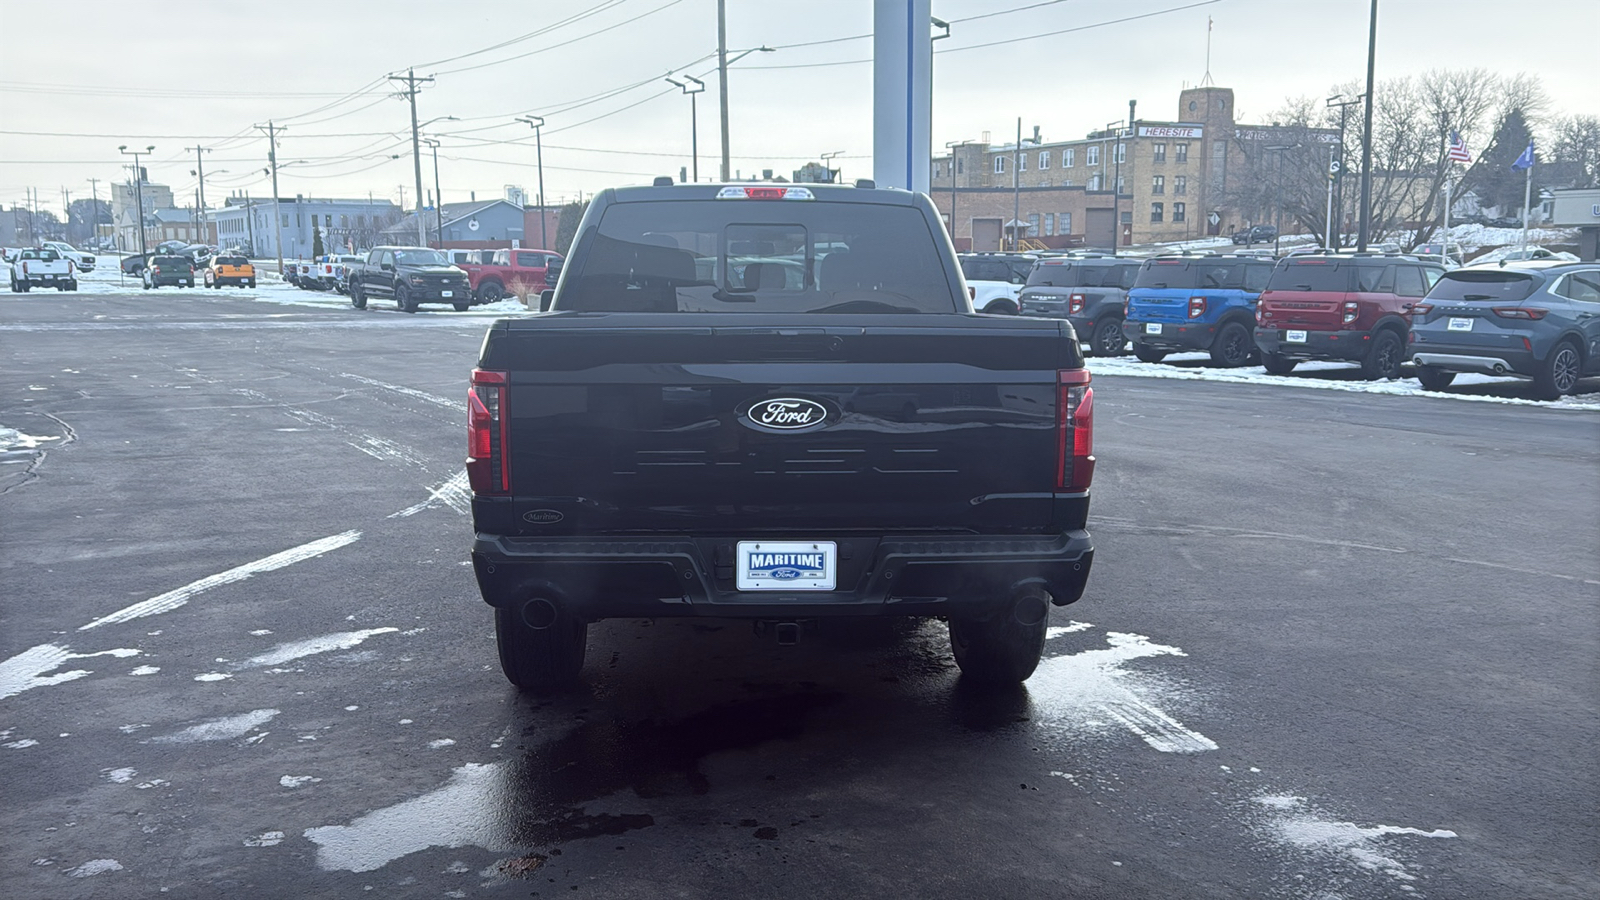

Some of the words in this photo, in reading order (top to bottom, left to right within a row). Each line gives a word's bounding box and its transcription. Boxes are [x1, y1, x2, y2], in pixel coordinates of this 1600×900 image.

[1145, 127, 1194, 137] HERESITE
[762, 402, 812, 423] Ford
[751, 554, 822, 569] MARITIME
[775, 570, 796, 578] Ford
